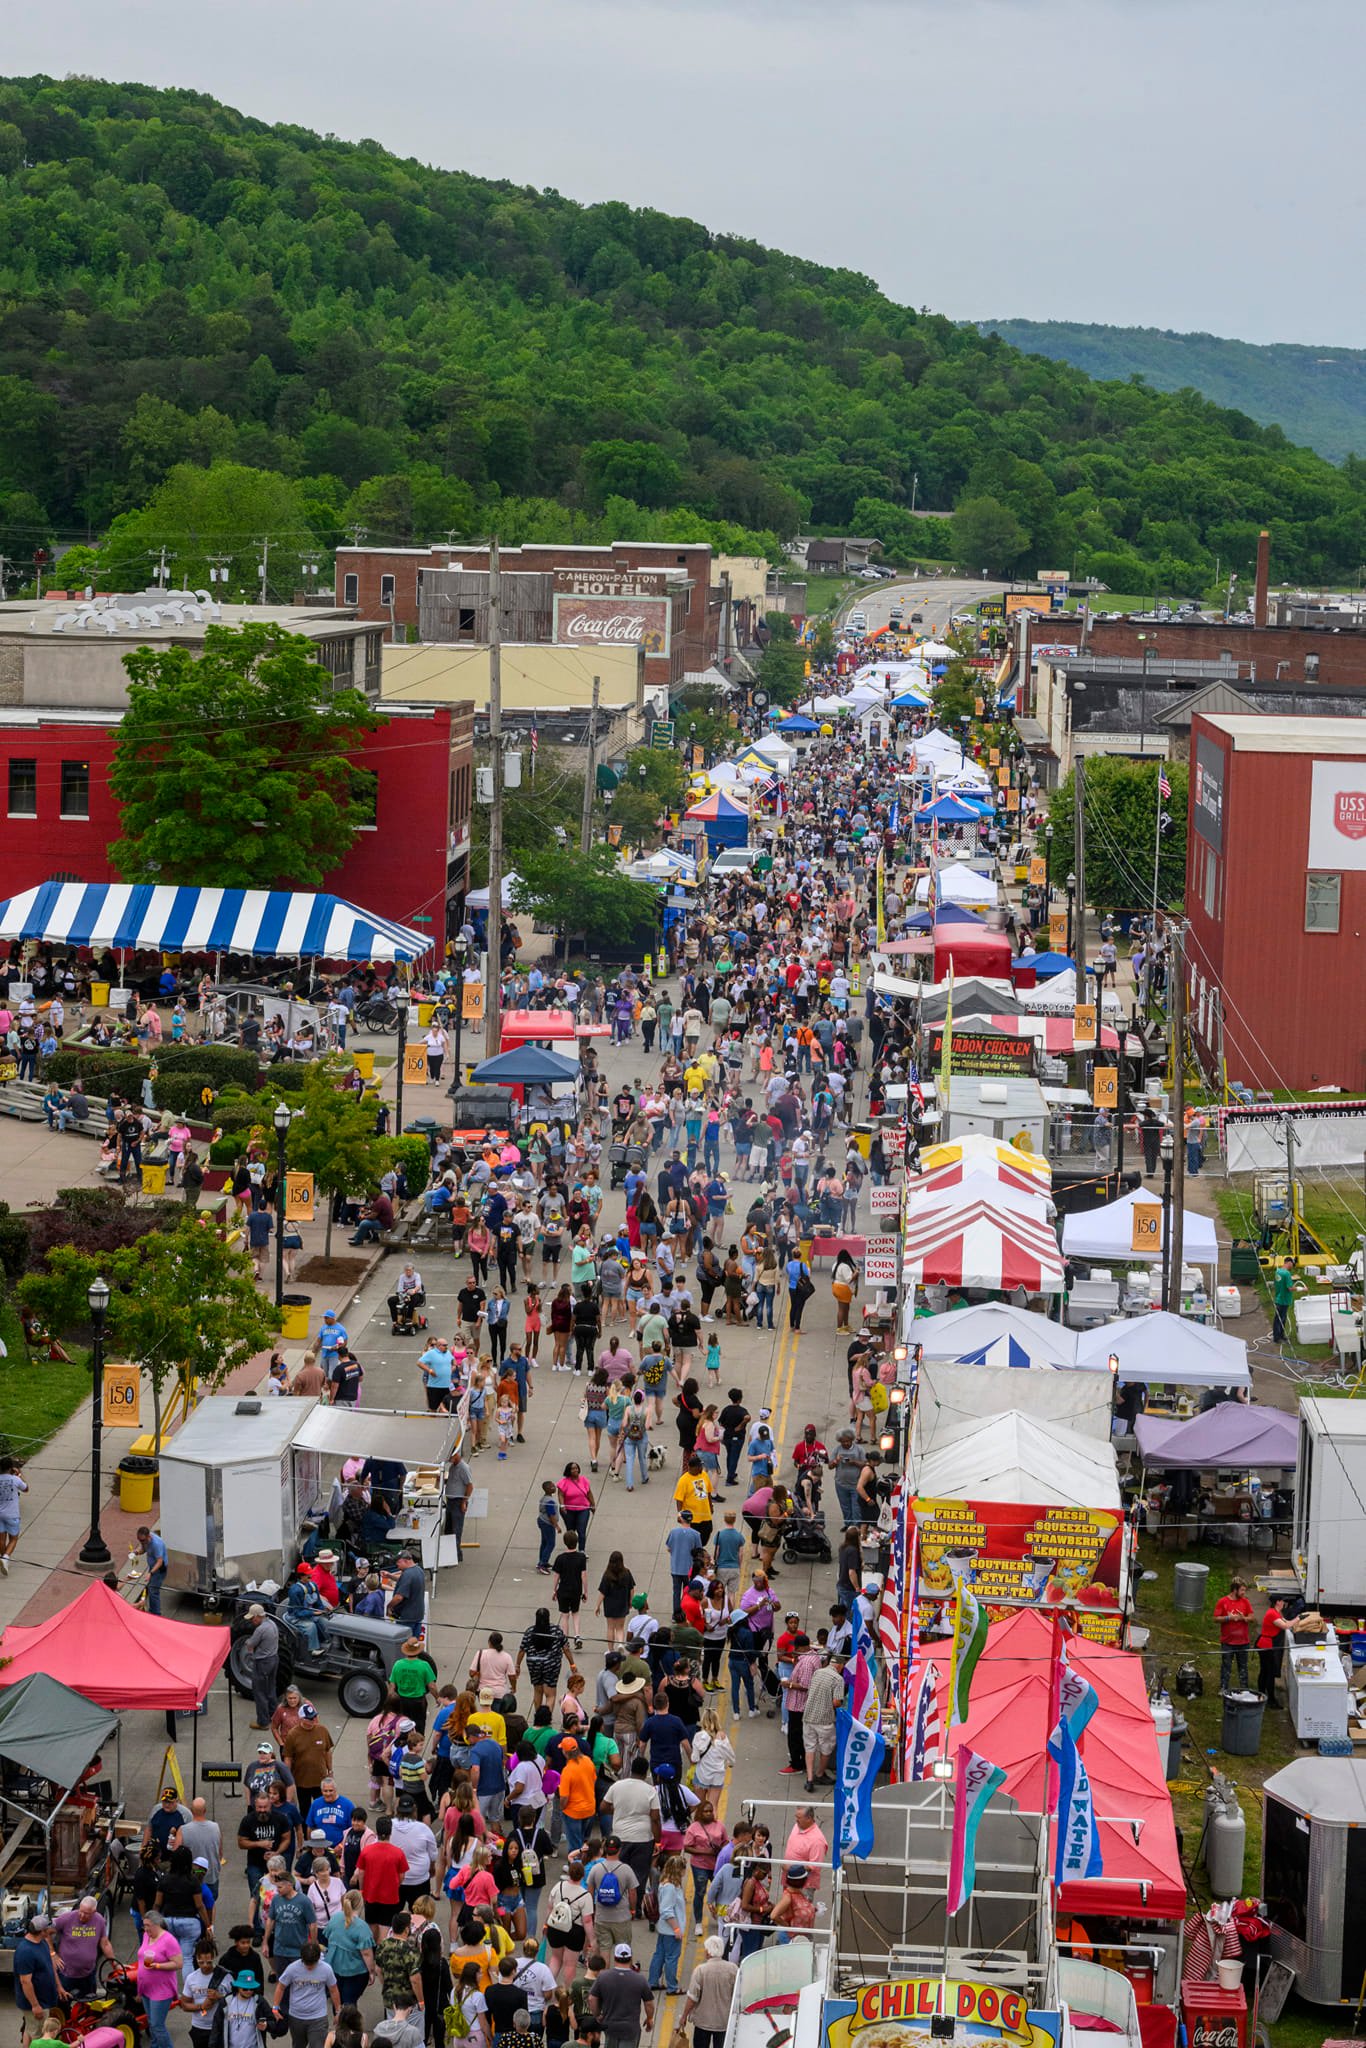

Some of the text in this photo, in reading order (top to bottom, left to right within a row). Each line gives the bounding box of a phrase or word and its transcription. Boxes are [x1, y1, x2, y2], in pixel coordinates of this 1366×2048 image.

[573, 581, 650, 596] HOTEL
[567, 613, 647, 640] Coca-Cola
[1340, 797, 1366, 811] USS
[466, 995, 480, 1006] 150
[1077, 1016, 1092, 1028] 150
[933, 1037, 1031, 1057] BURBON CHICKEN
[408, 1056, 424, 1070] 150
[1098, 1080, 1114, 1093] 150
[1233, 1114, 1278, 1125] WELCOME
[1295, 1112, 1314, 1121] THE
[1316, 1110, 1349, 1120] WORLD
[290, 1188, 310, 1203] 150
[872, 1190, 897, 1199] CORN
[871, 1200, 898, 1208] DOGS
[1137, 1218, 1157, 1234] 150
[868, 1238, 895, 1246] CORN
[867, 1246, 895, 1255] DOGS
[866, 1260, 895, 1269] CORN
[866, 1270, 895, 1279] DOGS
[110, 1385, 135, 1405] 150
[935, 1509, 975, 1521] FRESH
[1047, 1510, 1087, 1521] FRESH
[923, 1521, 985, 1535] SQUEEZED
[1036, 1521, 1098, 1535] SQUEEZED
[921, 1533, 985, 1547] LEMONADE
[1025, 1533, 1107, 1548] STRAWBERRY
[1033, 1546, 1097, 1560] LEMONADE
[969, 1558, 1034, 1571] SOUTHERN
[981, 1571, 1021, 1584] STYLE
[966, 1584, 1035, 1599] SWEET TEA
[845, 1731, 870, 1781] COLD
[1066, 1799, 1089, 1870] WATER
[861, 1981, 1024, 2029] CHILI DOG
